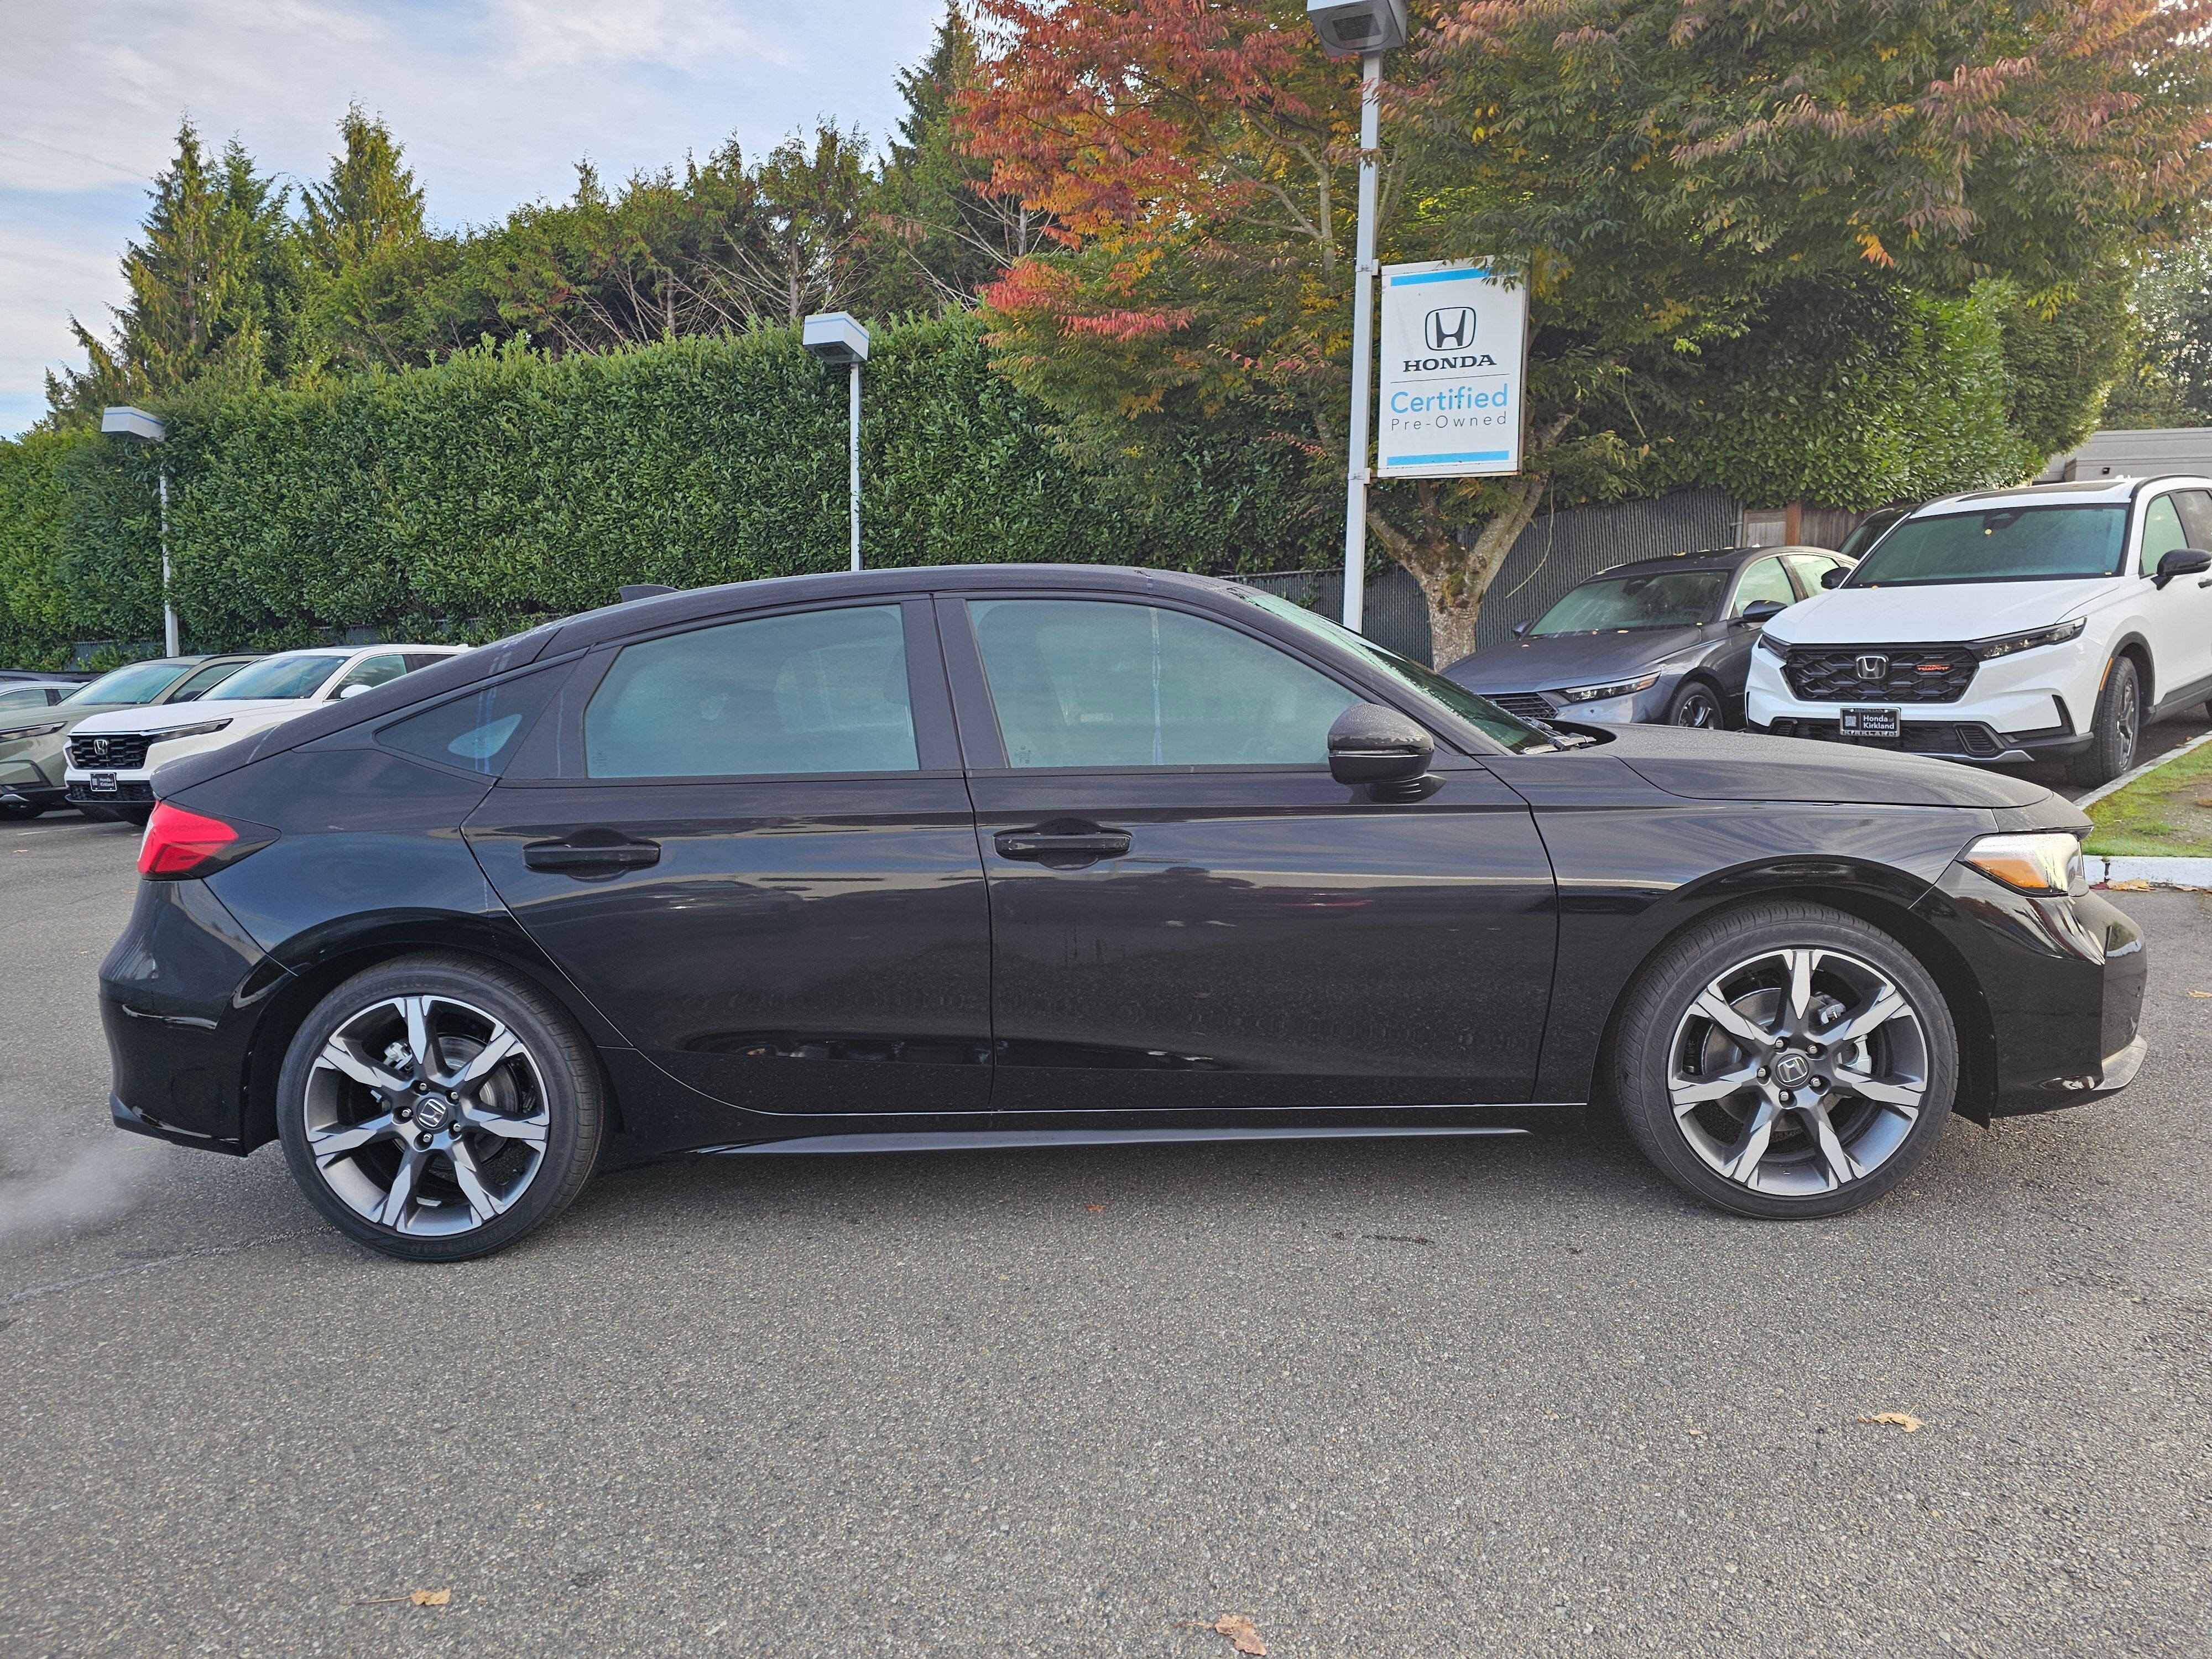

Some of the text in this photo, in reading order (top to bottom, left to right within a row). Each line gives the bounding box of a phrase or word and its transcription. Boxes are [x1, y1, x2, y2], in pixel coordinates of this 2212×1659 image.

[1402, 354, 1498, 372] HONDA
[1390, 383, 1508, 414] Certified
[1391, 411, 1507, 431] Pre-Owned
